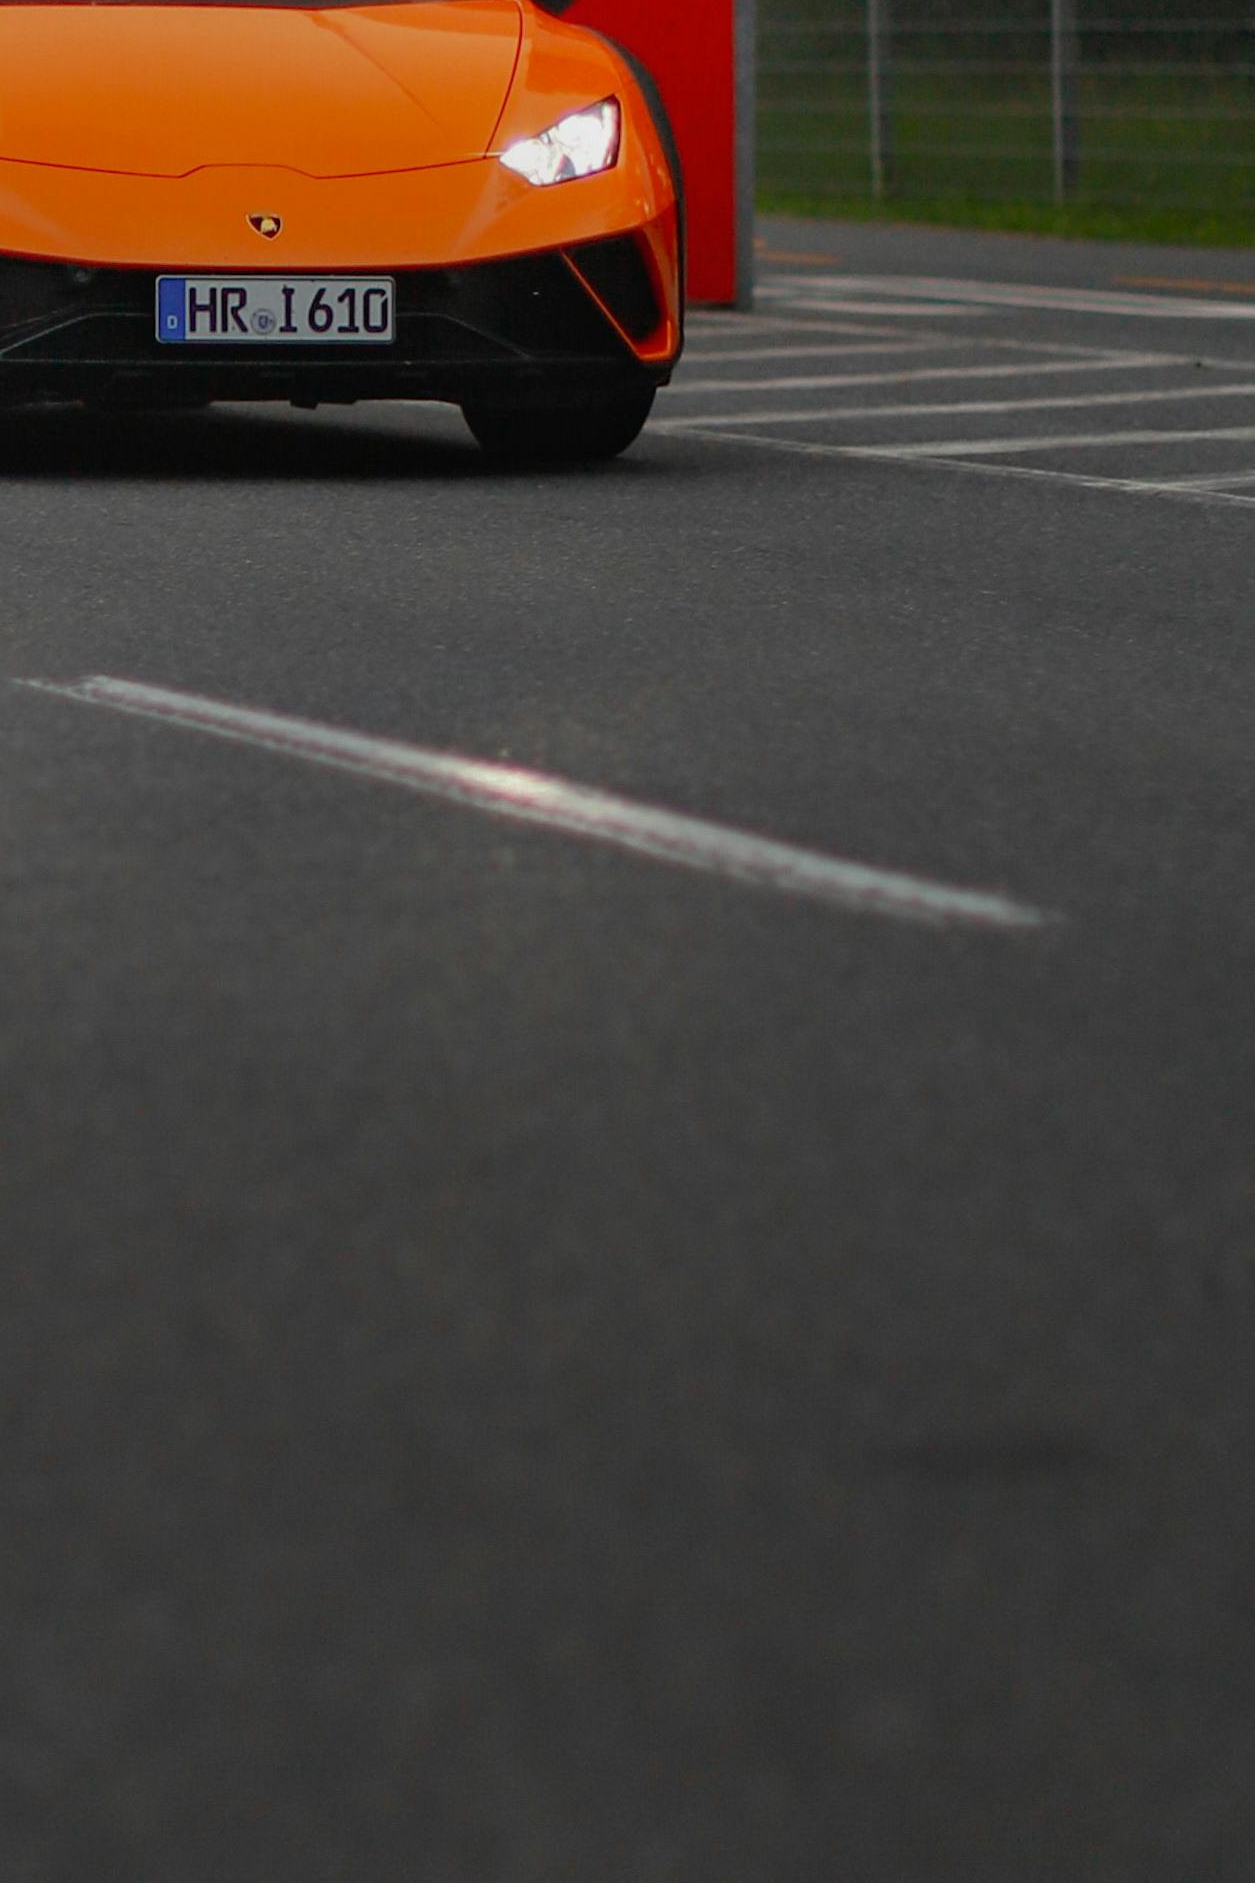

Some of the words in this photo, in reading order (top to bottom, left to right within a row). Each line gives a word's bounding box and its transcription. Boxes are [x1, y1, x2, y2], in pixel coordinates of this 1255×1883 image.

[167, 315, 178, 330] D
[189, 287, 248, 333] HR
[308, 288, 389, 333] 610
